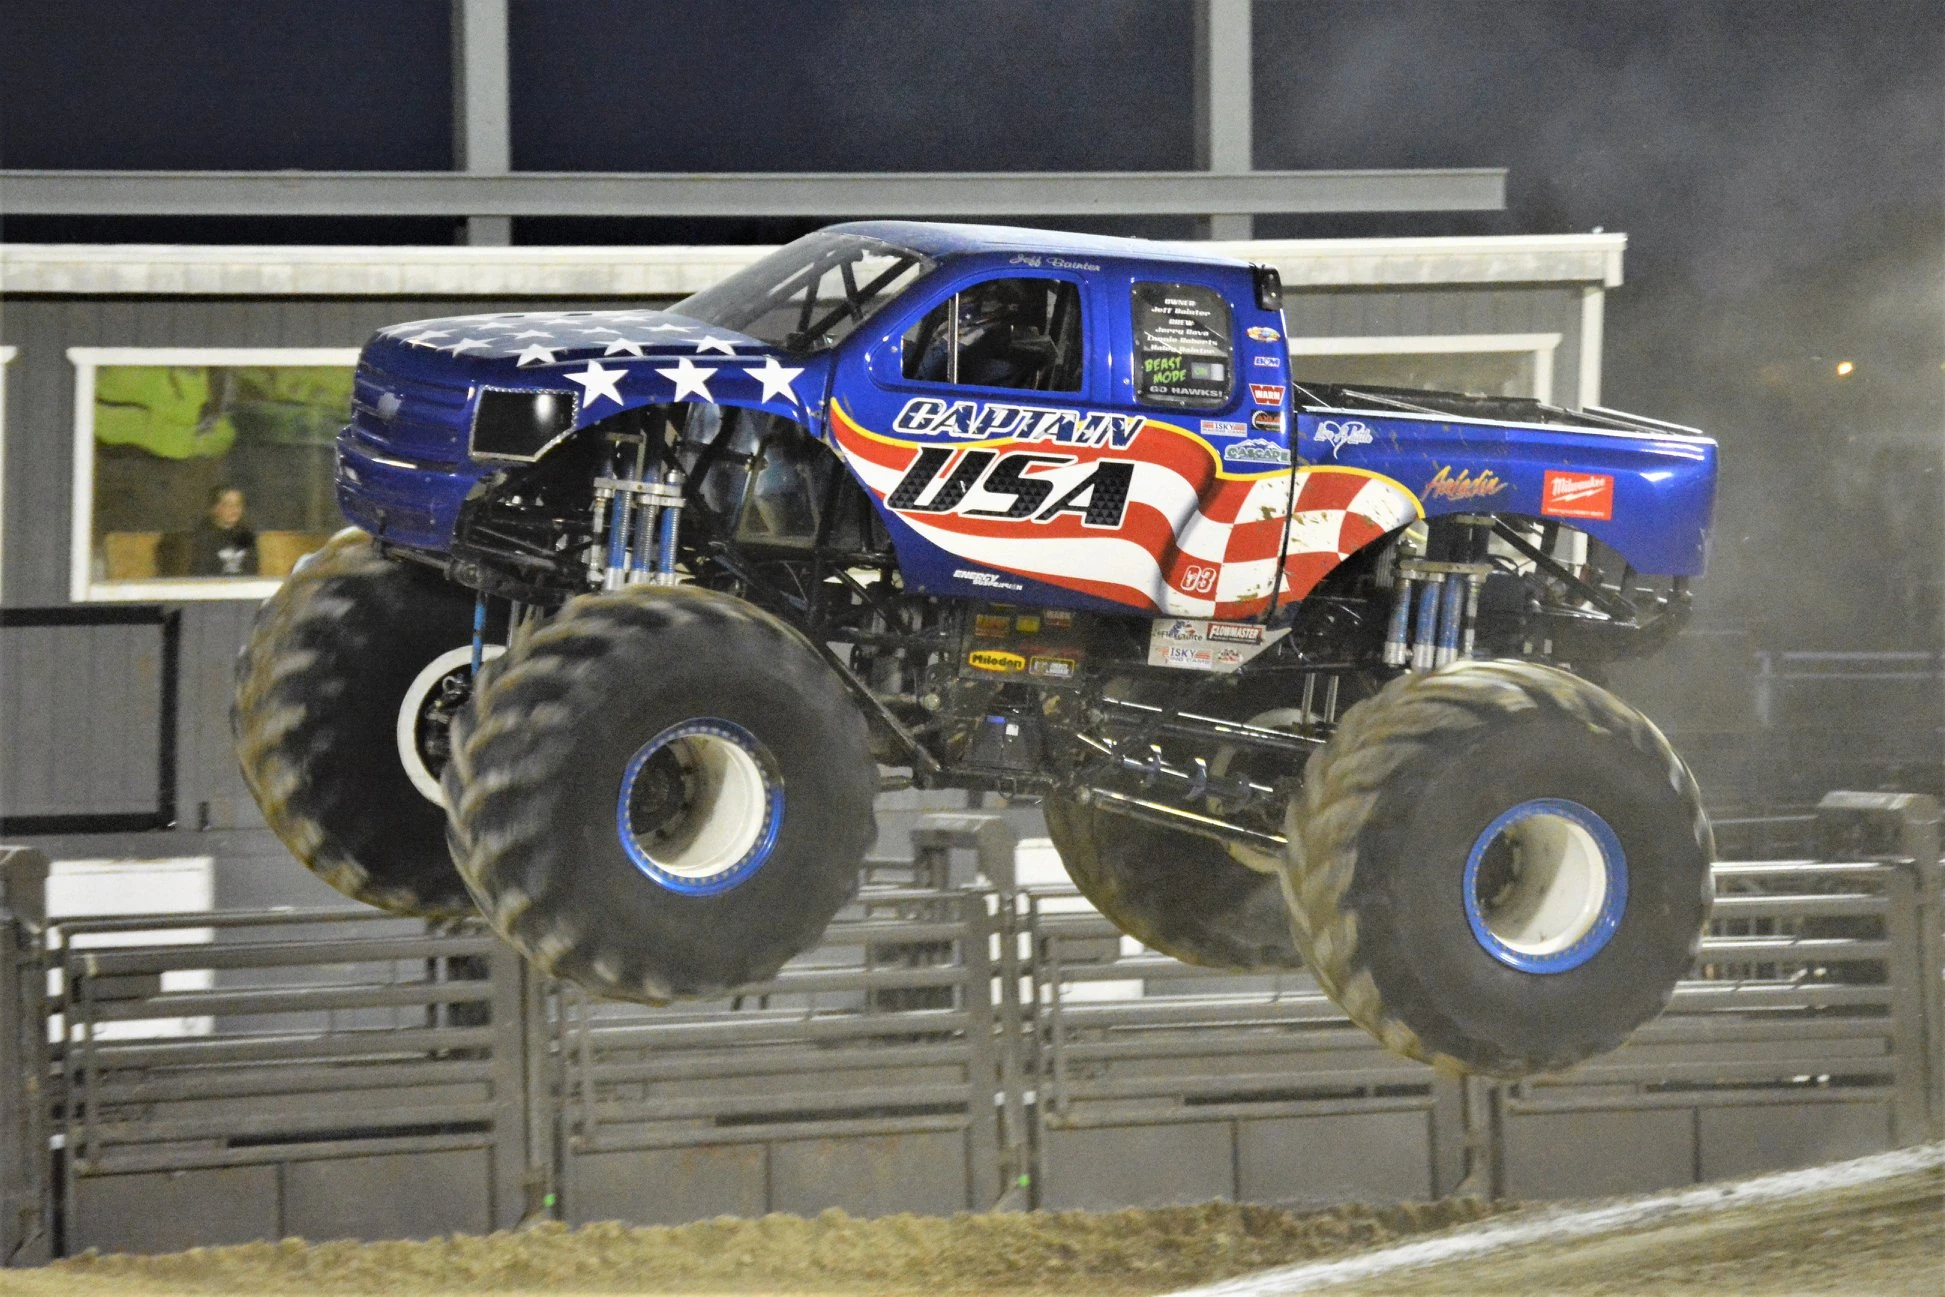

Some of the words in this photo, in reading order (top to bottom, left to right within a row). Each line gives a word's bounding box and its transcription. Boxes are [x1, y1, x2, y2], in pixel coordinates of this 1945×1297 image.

[1144, 356, 1182, 372] BEAST
[1153, 369, 1187, 384] MODE
[1149, 385, 1168, 393] GO
[1170, 387, 1223, 398] HAWKS!
[1254, 389, 1280, 400] WARN
[894, 397, 1146, 450] CAPTAIN
[1214, 422, 1234, 430] ISKY
[1226, 446, 1290, 461] CASCADE
[884, 445, 1136, 529] USA
[1208, 624, 1260, 639] FLOWMASTER
[1170, 647, 1196, 656] ISKY
